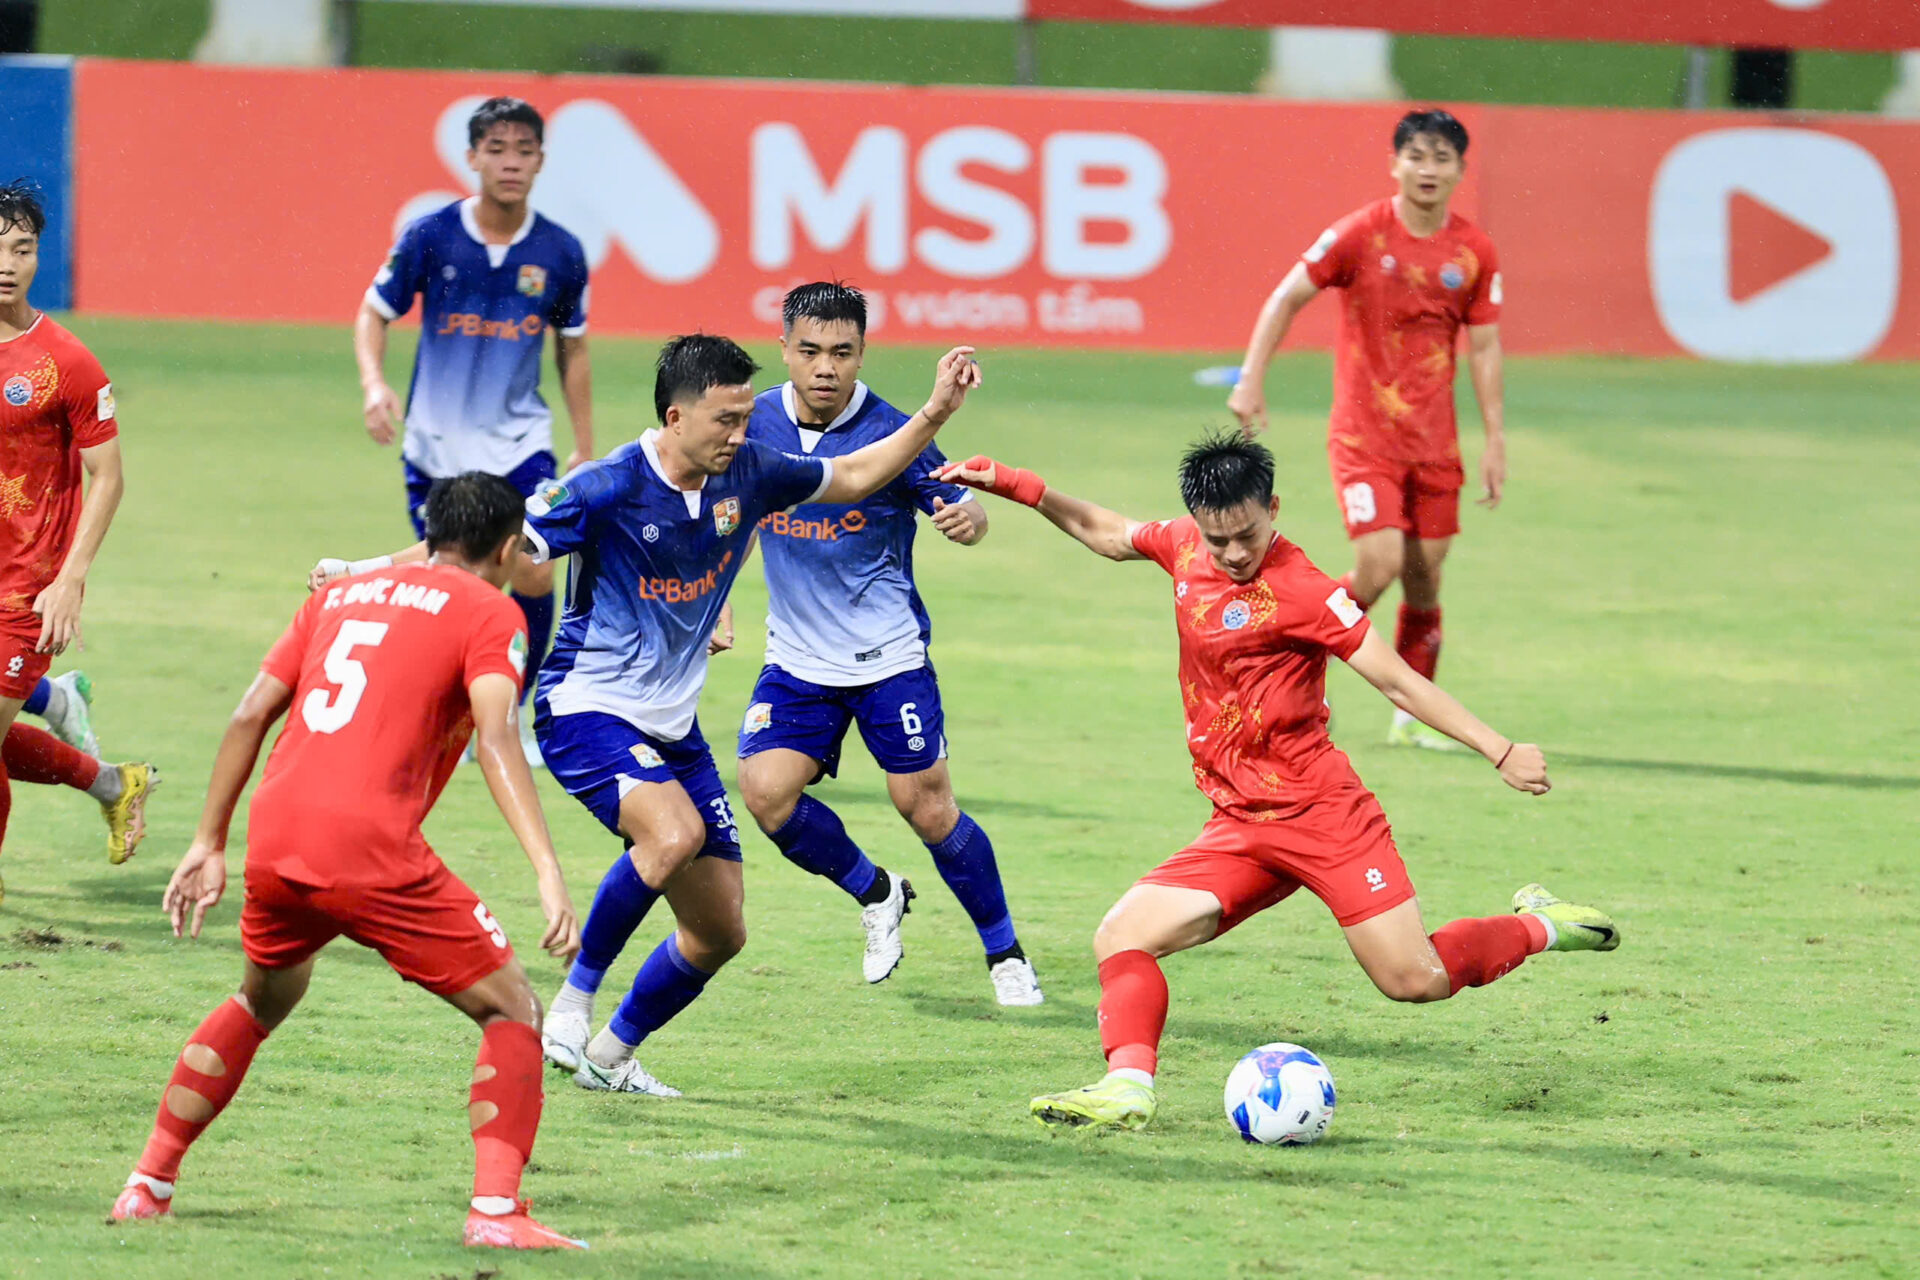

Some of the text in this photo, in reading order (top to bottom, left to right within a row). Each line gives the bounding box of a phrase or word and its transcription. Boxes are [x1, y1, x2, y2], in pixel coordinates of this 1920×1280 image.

[750, 121, 1173, 280] MSB
[389, 581, 450, 615] NAM
[301, 619, 389, 734] 5
[899, 702, 922, 735] 6
[473, 902, 507, 949] 5
